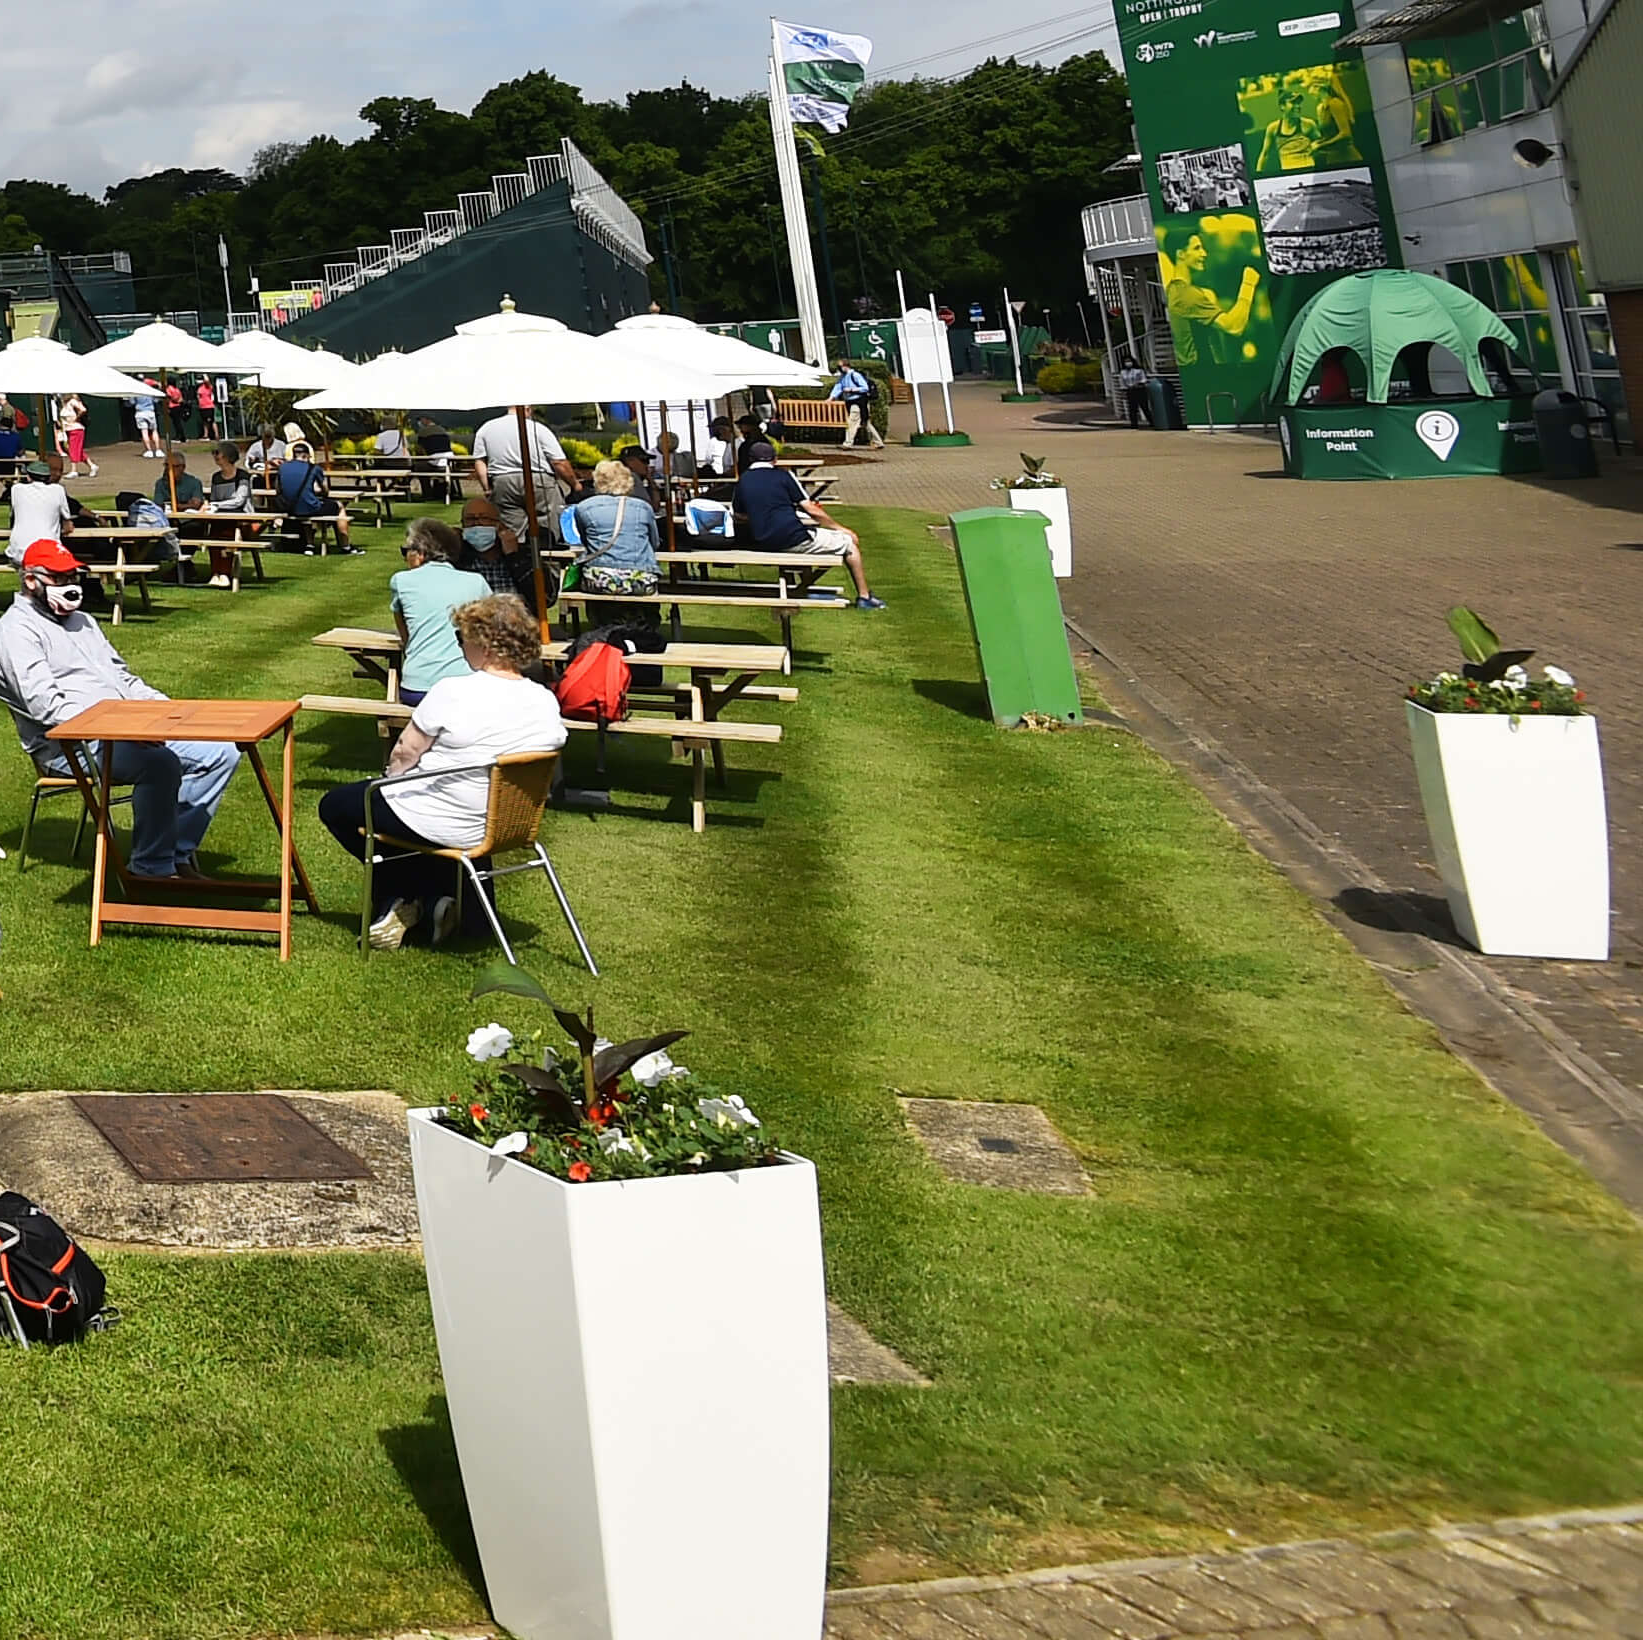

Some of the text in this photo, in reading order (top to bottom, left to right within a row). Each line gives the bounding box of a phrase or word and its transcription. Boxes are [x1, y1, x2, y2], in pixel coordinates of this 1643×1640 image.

[1139, 3, 1202, 24] OPEN TROPHY
[1306, 428, 1374, 438] Information
[1326, 441, 1358, 451] Point
